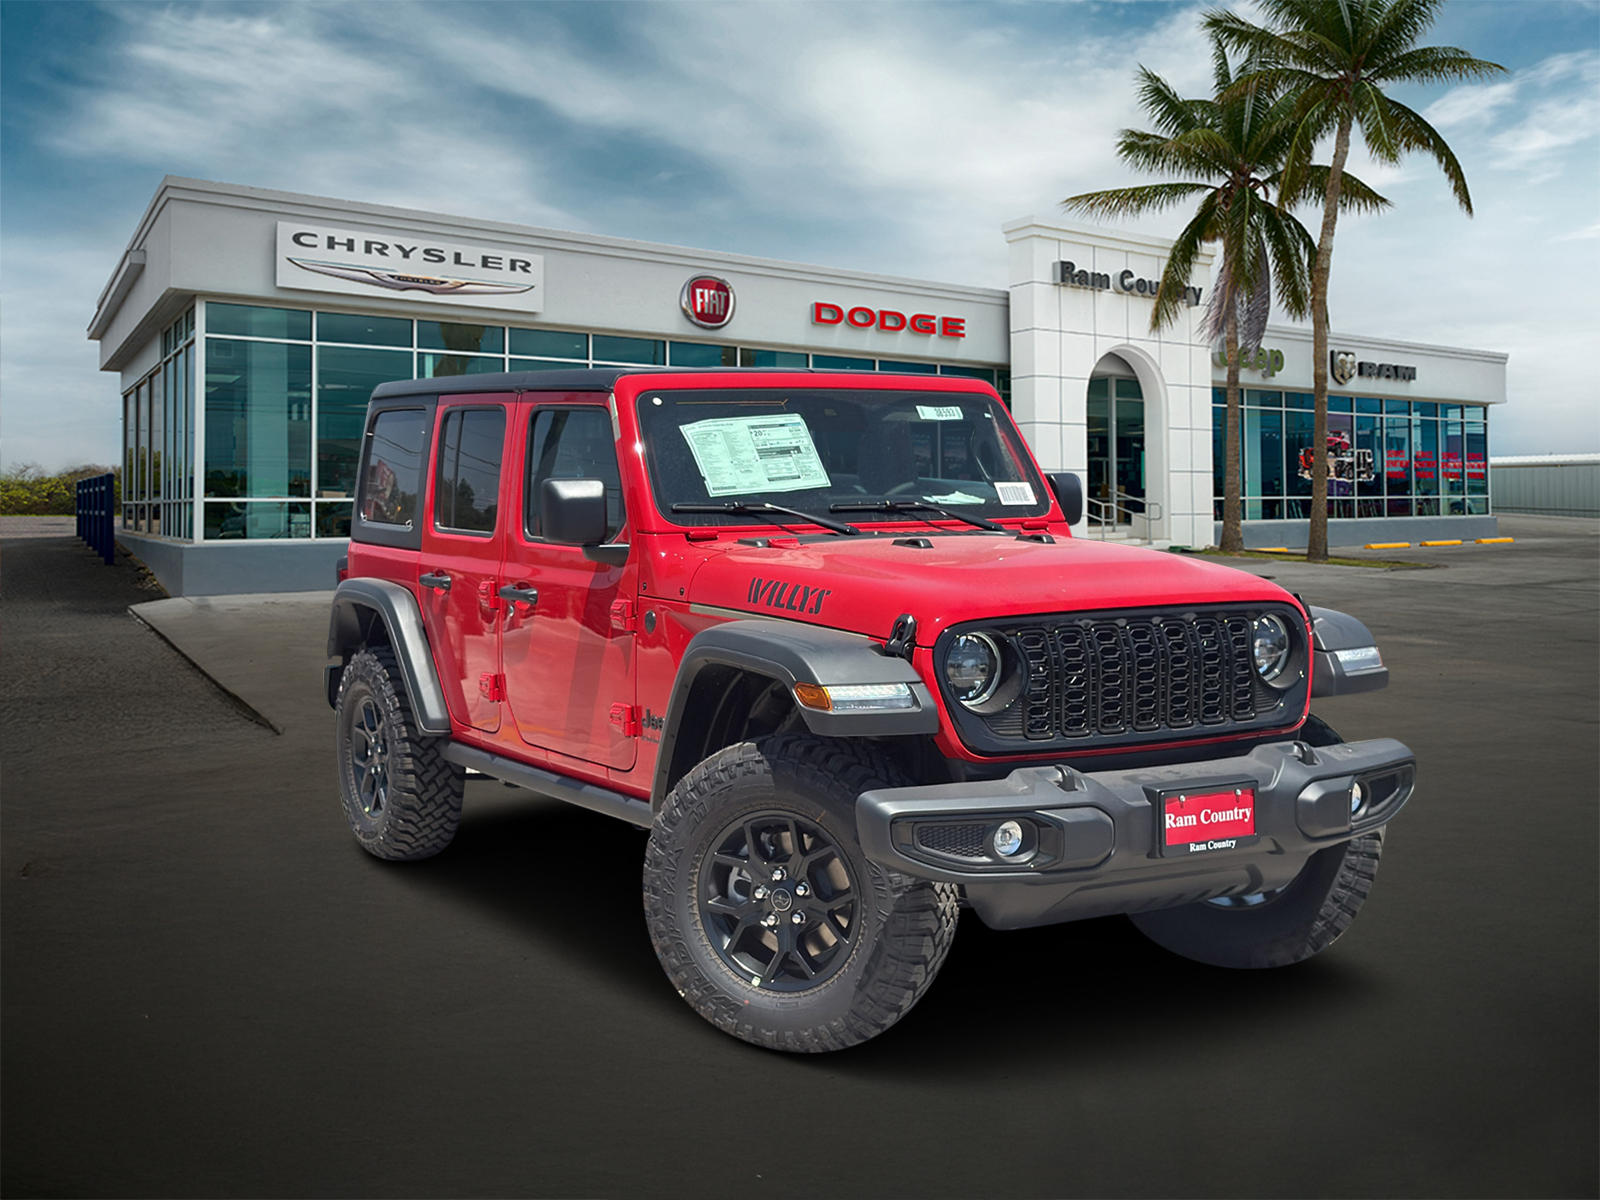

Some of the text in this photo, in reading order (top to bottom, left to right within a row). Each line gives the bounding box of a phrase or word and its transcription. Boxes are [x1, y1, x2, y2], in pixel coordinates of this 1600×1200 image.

[291, 231, 533, 274] CHRYSLER
[1058, 260, 1203, 306] Ram Coury
[695, 287, 728, 316] FIAT
[813, 301, 967, 339] DODGE
[1358, 361, 1417, 381] RAM
[747, 576, 833, 615] WILLYS
[641, 708, 666, 731] Jee
[1165, 805, 1252, 829] Ram Country
[1189, 839, 1237, 852] Ram Country
